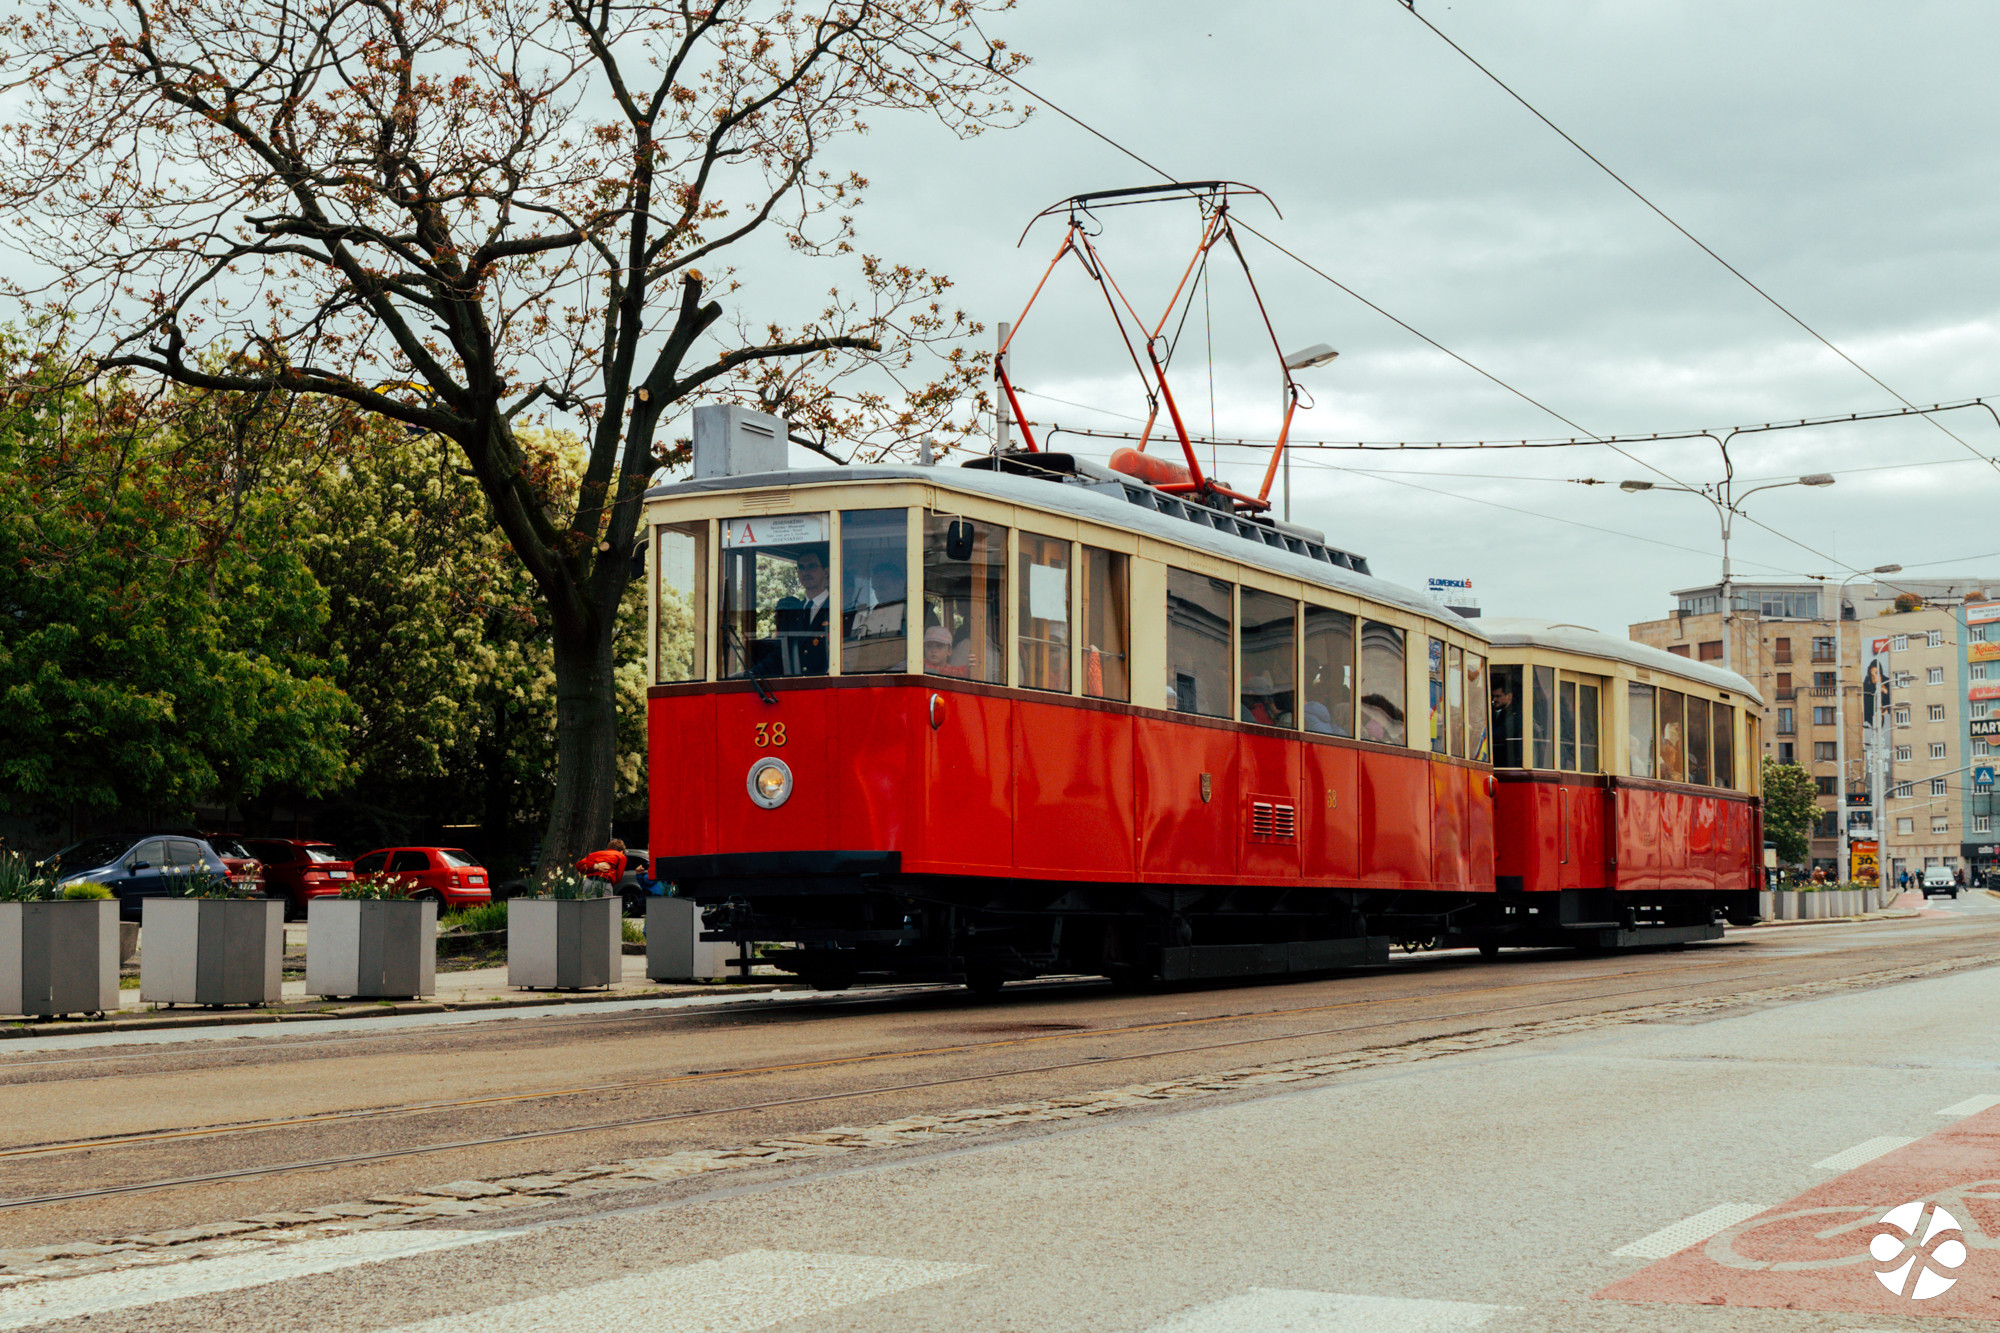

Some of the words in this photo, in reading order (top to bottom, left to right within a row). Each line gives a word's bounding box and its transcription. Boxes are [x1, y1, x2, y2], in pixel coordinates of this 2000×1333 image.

[739, 522, 757, 543] A
[755, 721, 787, 748] 38
[1327, 789, 1337, 809] 38
